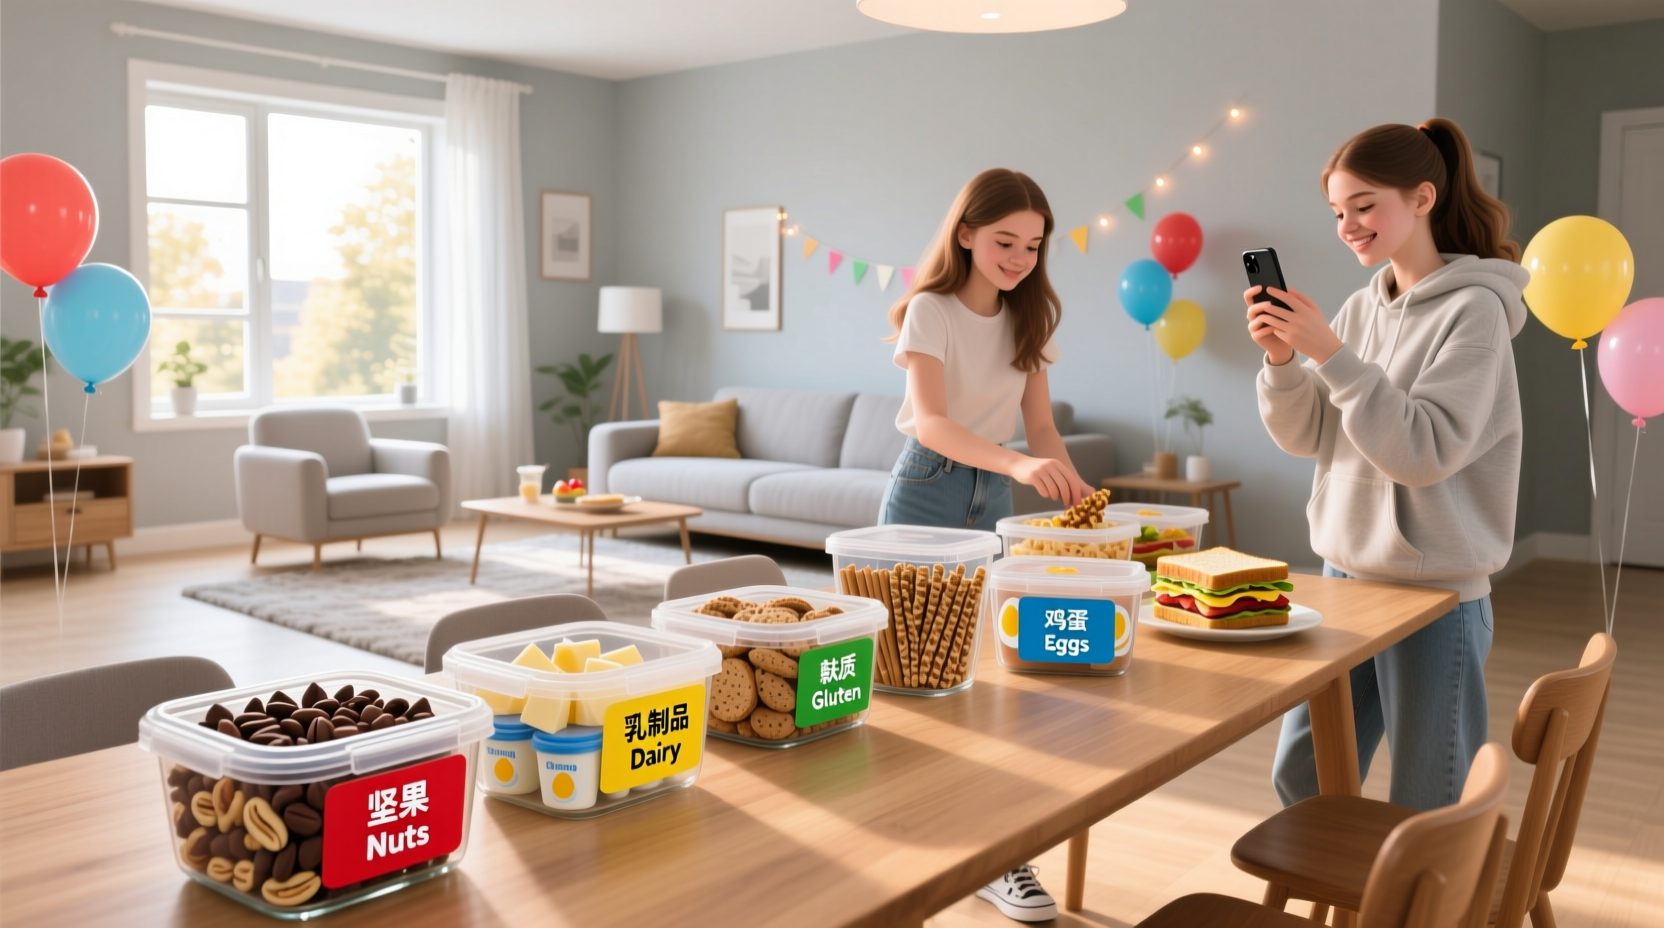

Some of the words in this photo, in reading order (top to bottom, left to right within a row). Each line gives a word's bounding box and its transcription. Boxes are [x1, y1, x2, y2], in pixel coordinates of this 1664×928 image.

[1044, 608, 1089, 632] 鸡蛋
[1044, 634, 1090, 657] Eggs
[811, 686, 861, 710] Gluten
[624, 702, 689, 743] 乳制品
[630, 741, 682, 770] Dairy
[367, 779, 430, 828] 坚果
[366, 824, 430, 861] Nuts
